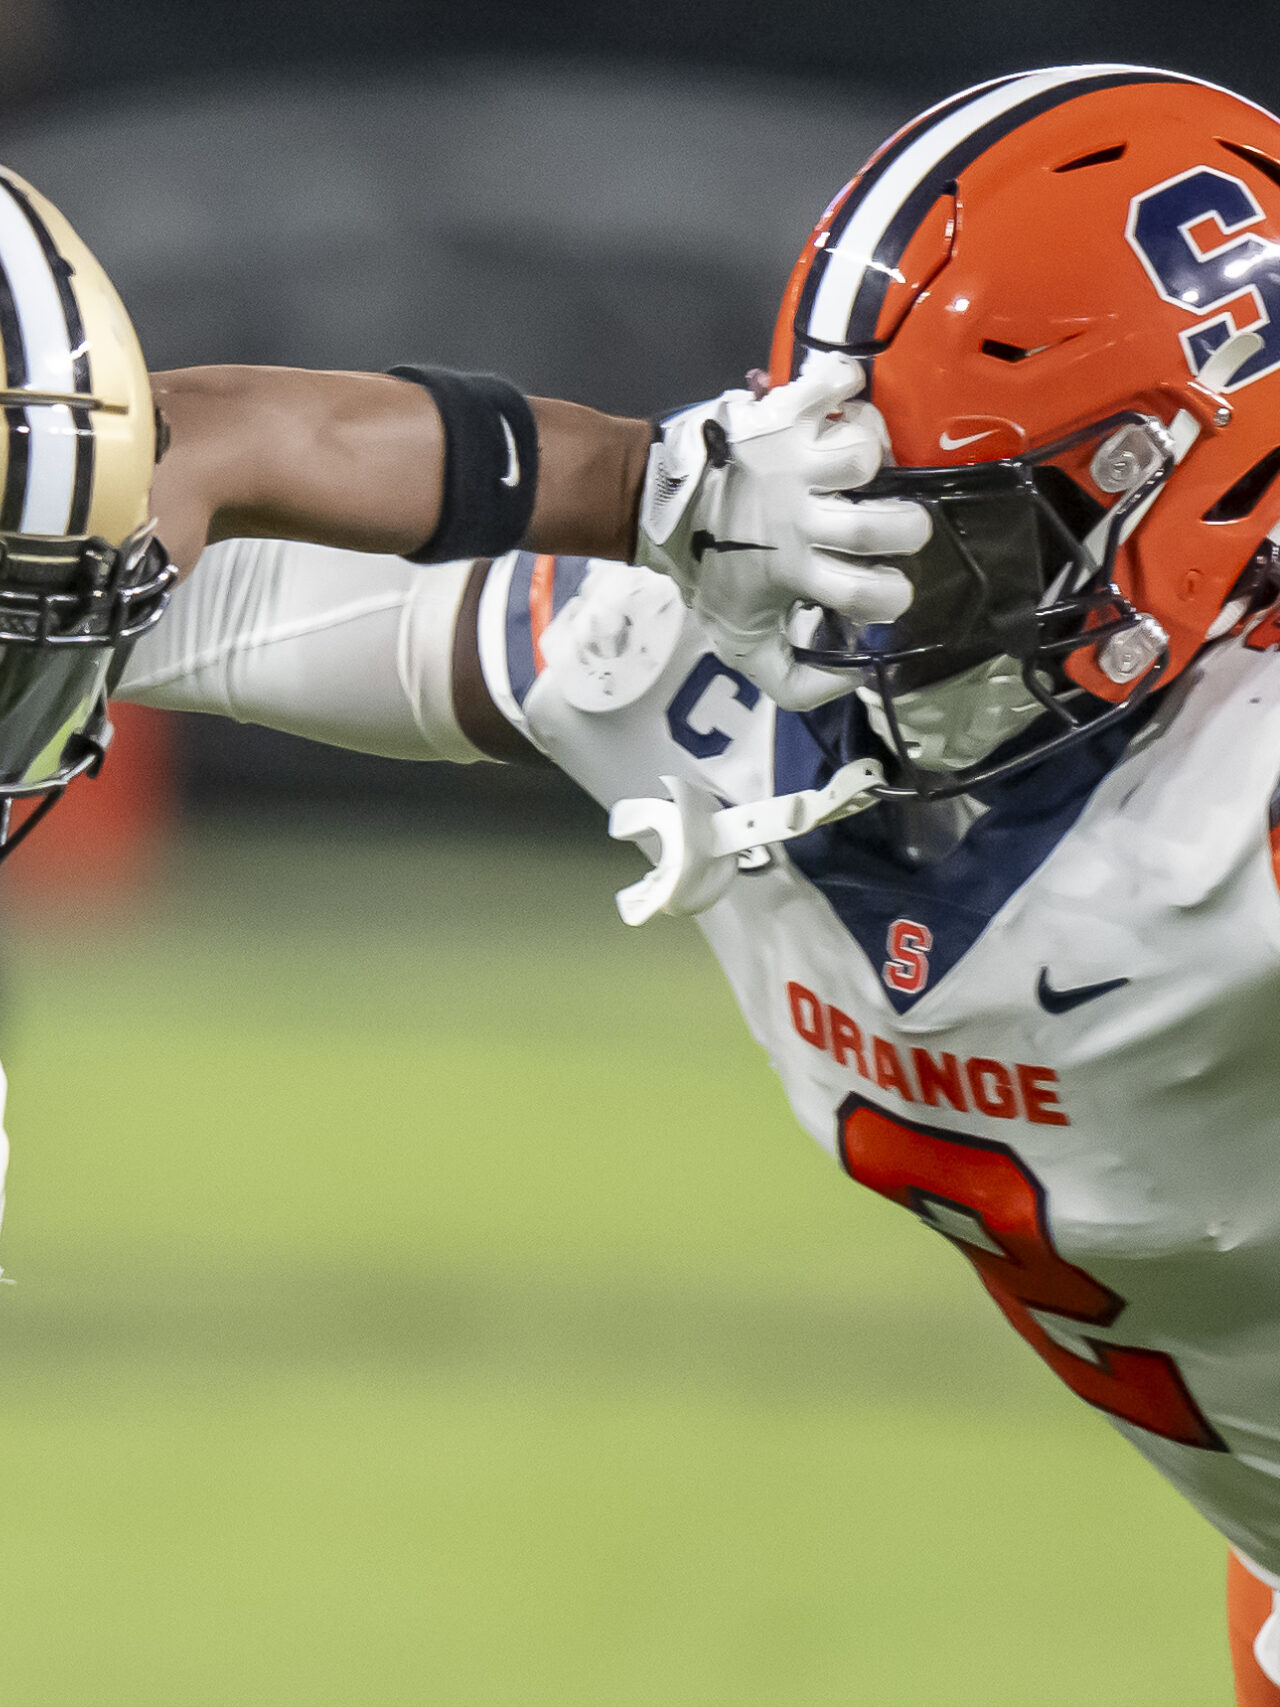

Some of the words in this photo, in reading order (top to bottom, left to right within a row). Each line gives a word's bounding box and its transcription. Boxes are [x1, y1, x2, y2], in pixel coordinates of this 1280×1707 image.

[1124, 165, 1280, 393] S
[666, 651, 761, 759] C
[884, 919, 934, 994] S
[786, 980, 1071, 1127] ORANGE
[836, 1091, 1231, 1452] 2
